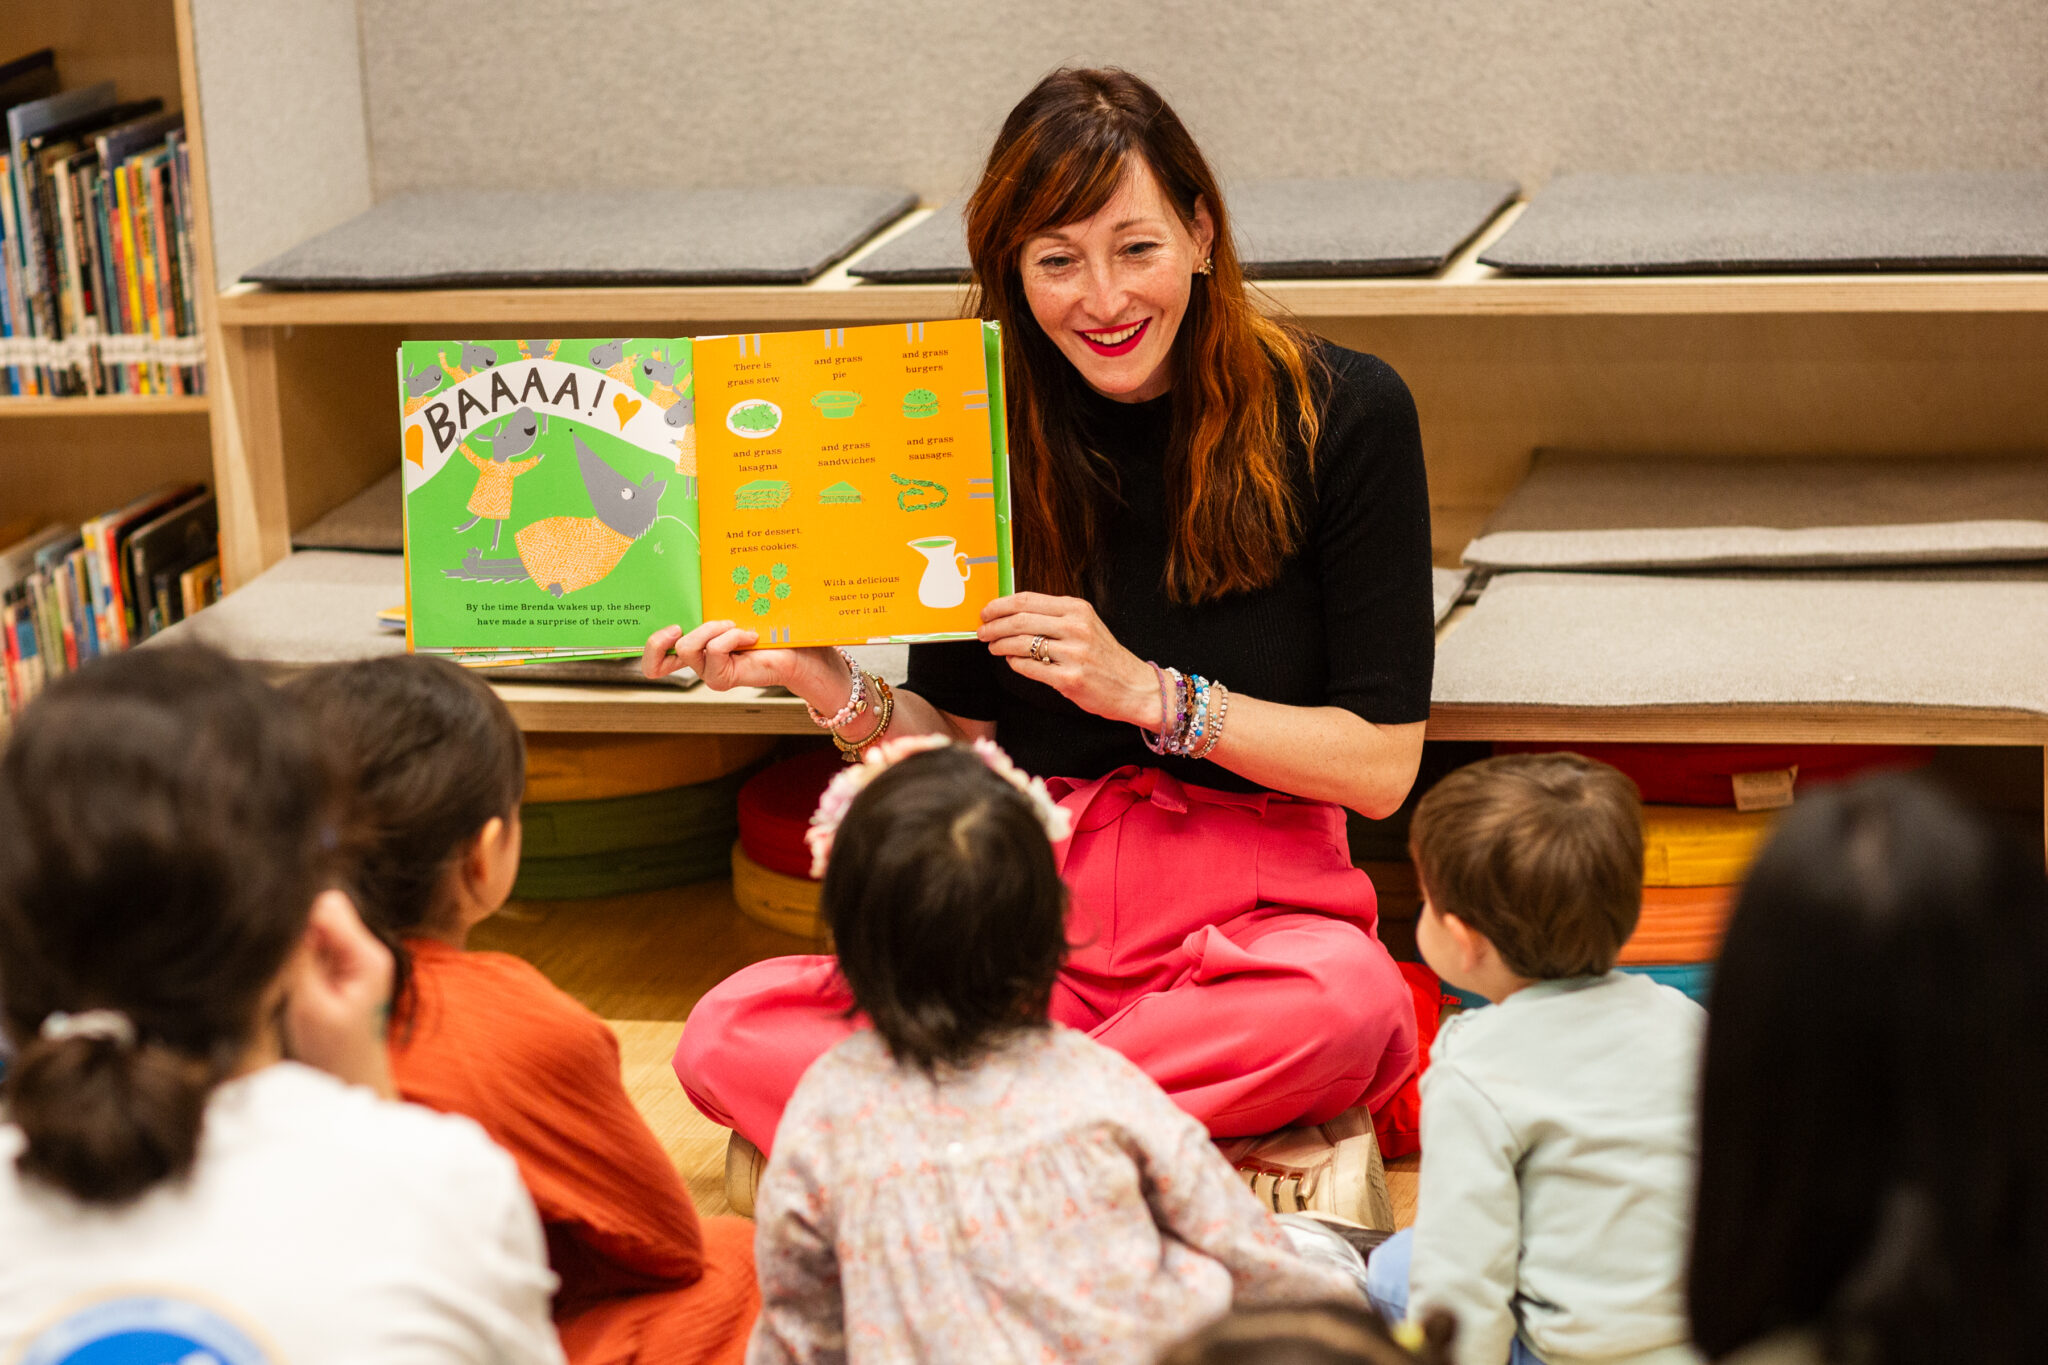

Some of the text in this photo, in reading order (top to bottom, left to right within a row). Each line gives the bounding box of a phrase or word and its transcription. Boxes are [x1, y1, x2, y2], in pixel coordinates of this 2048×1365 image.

[902, 349, 949, 358] and grass
[813, 355, 863, 365] and grass
[733, 361, 773, 371] There is
[905, 364, 944, 373] burgers
[832, 371, 847, 380] pie
[727, 376, 780, 388] grass stew
[424, 367, 606, 453] BAAAA!
[906, 436, 955, 445] and grass
[821, 442, 871, 451] and grass
[733, 448, 783, 457] and grass
[817, 456, 876, 466] sandwiches
[738, 463, 778, 472] lasagna
[726, 530, 744, 538] And
[746, 529, 763, 537] for
[729, 542, 799, 555] grass cookies.
[823, 578, 846, 586] With
[856, 575, 900, 584] delicious
[829, 591, 895, 602] sauce to pour
[465, 603, 479, 612] By
[481, 602, 496, 610] the
[498, 603, 519, 611] time
[520, 603, 555, 611] Brenda
[556, 602, 589, 610] wakes
[606, 602, 622, 610] the
[623, 602, 651, 612] sheep
[838, 608, 862, 616] over
[476, 617, 500, 625] have
[501, 617, 527, 625] made
[536, 617, 578, 627] surprise
[578, 617, 590, 625] of
[591, 617, 615, 625] their
[616, 618, 641, 626] own.
